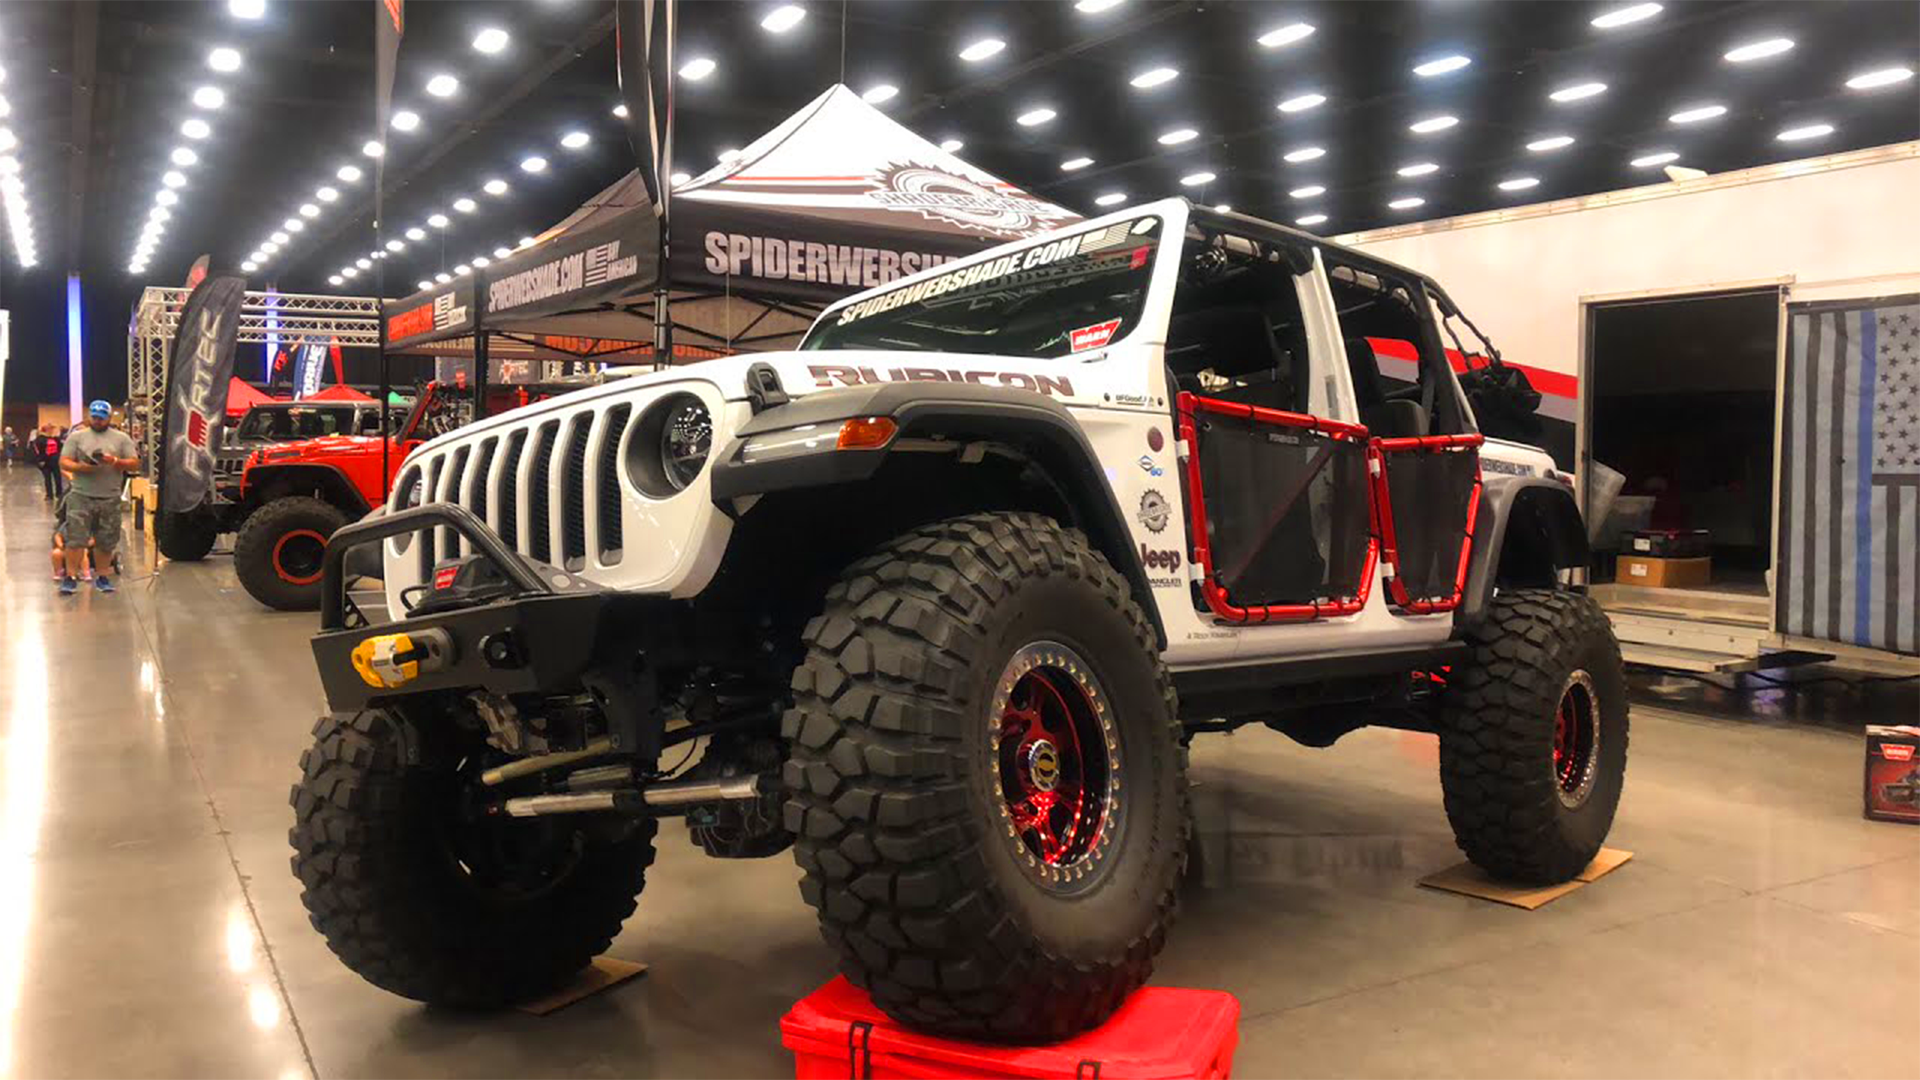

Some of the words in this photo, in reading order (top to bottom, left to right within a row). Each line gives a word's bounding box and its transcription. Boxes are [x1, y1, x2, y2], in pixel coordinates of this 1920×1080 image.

[704, 231, 958, 287] SPIDERWEBS
[836, 234, 1082, 326] SPIDERWEBSHADE.COM
[807, 365, 1075, 397] RUBICON
[1140, 543, 1181, 573] Jeep
